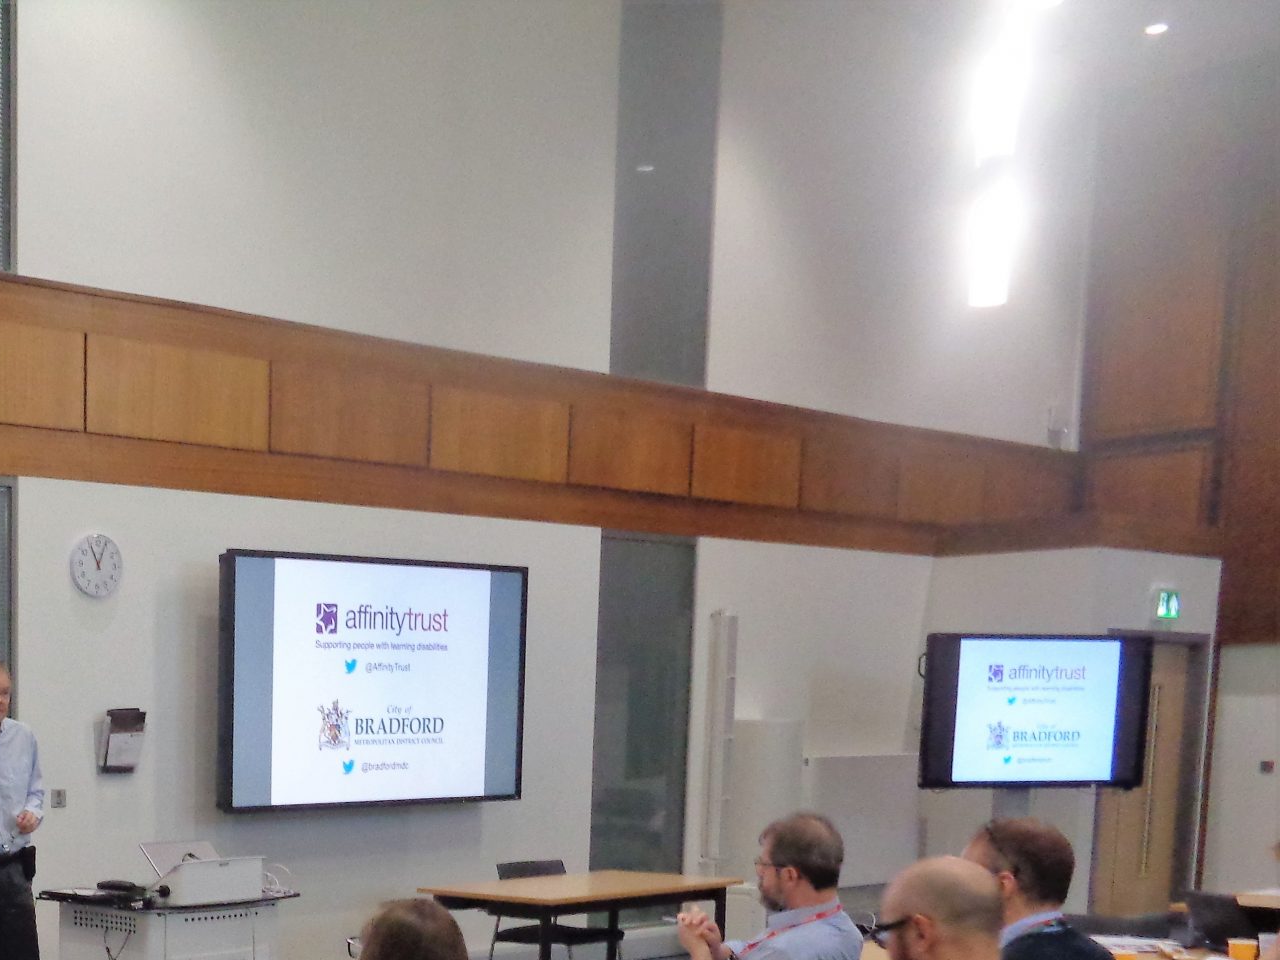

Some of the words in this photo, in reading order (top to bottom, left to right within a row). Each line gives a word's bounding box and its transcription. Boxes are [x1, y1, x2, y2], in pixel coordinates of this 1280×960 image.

[345, 604, 449, 636] affinitytrust
[315, 639, 351, 651] Supporting
[353, 641, 375, 651] people
[376, 641, 389, 650] with
[365, 662, 411, 673] @AffinityTrust
[1008, 664, 1087, 683] affinitytrust
[354, 717, 444, 735] BRADFORD
[1012, 731, 1081, 742] BRADFORD
